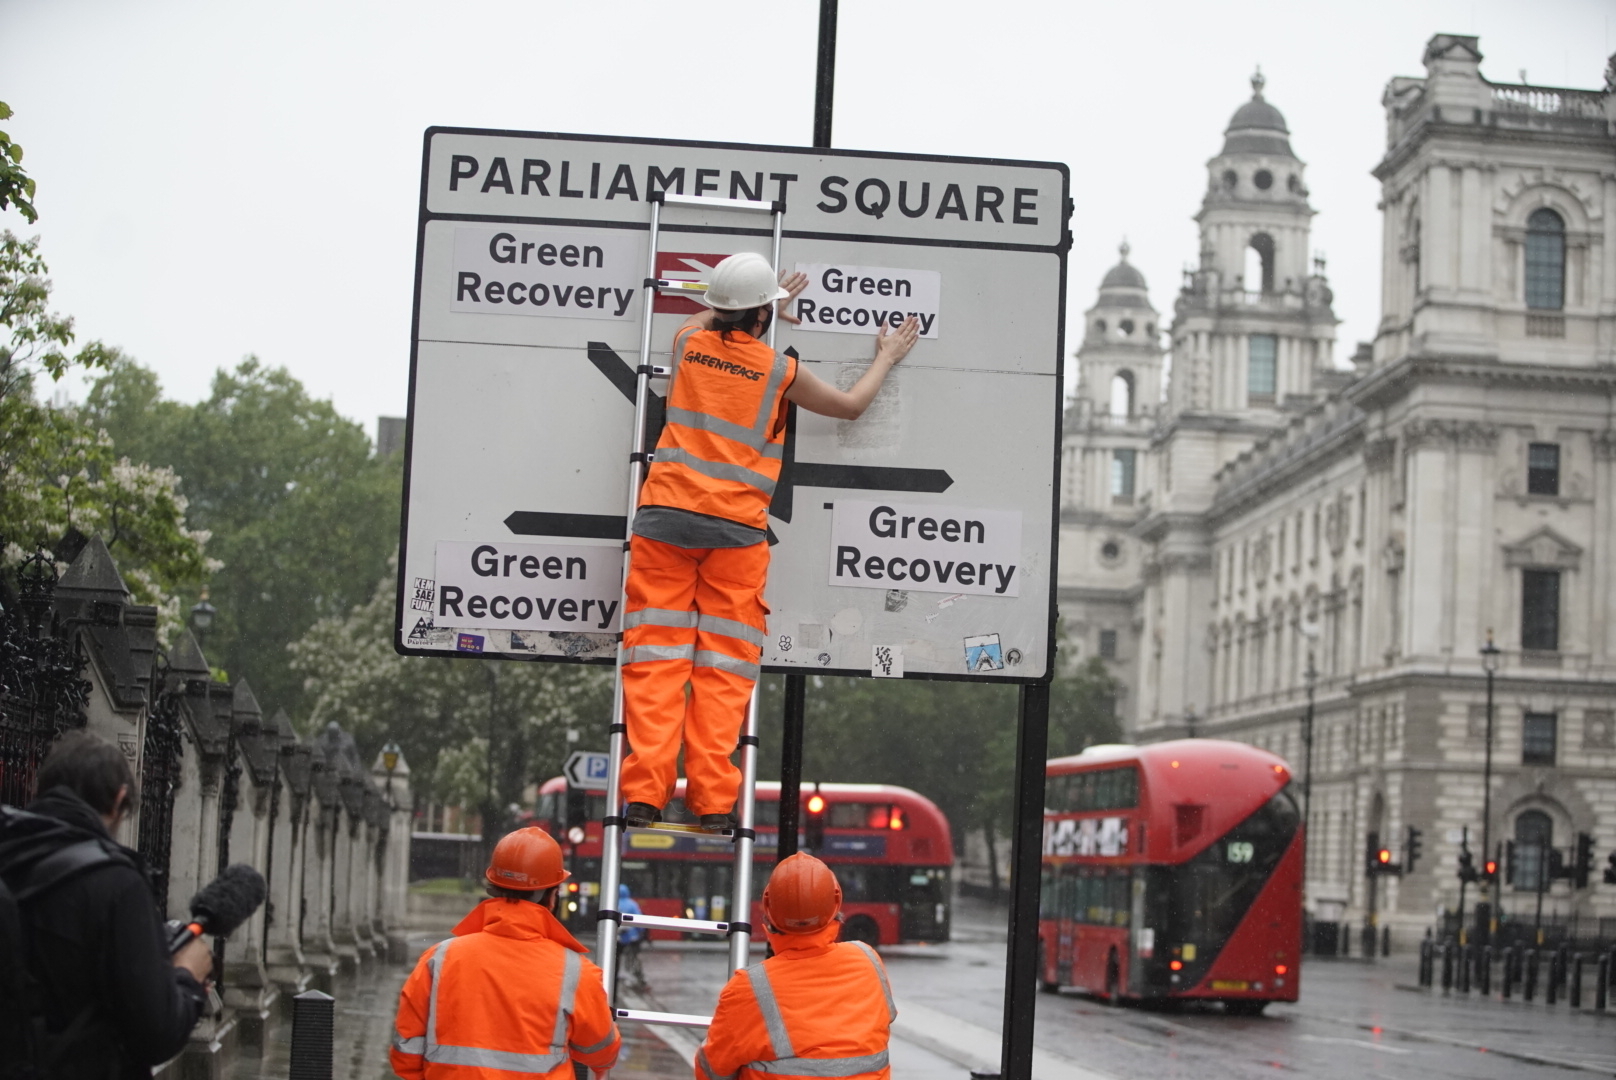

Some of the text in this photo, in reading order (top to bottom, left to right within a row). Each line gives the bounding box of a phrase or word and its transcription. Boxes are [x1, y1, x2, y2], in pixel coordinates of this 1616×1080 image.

[449, 154, 1039, 225] PARLIAMENT SQUARE
[489, 232, 604, 268] Green
[456, 271, 635, 317] Recovery
[822, 268, 912, 297] Green
[684, 350, 765, 381] GREENPEACE
[868, 505, 985, 544] Green
[471, 545, 587, 580] Green
[836, 545, 1016, 594] Recovery
[415, 577, 435, 591] KEM
[439, 585, 619, 630] Recovery
